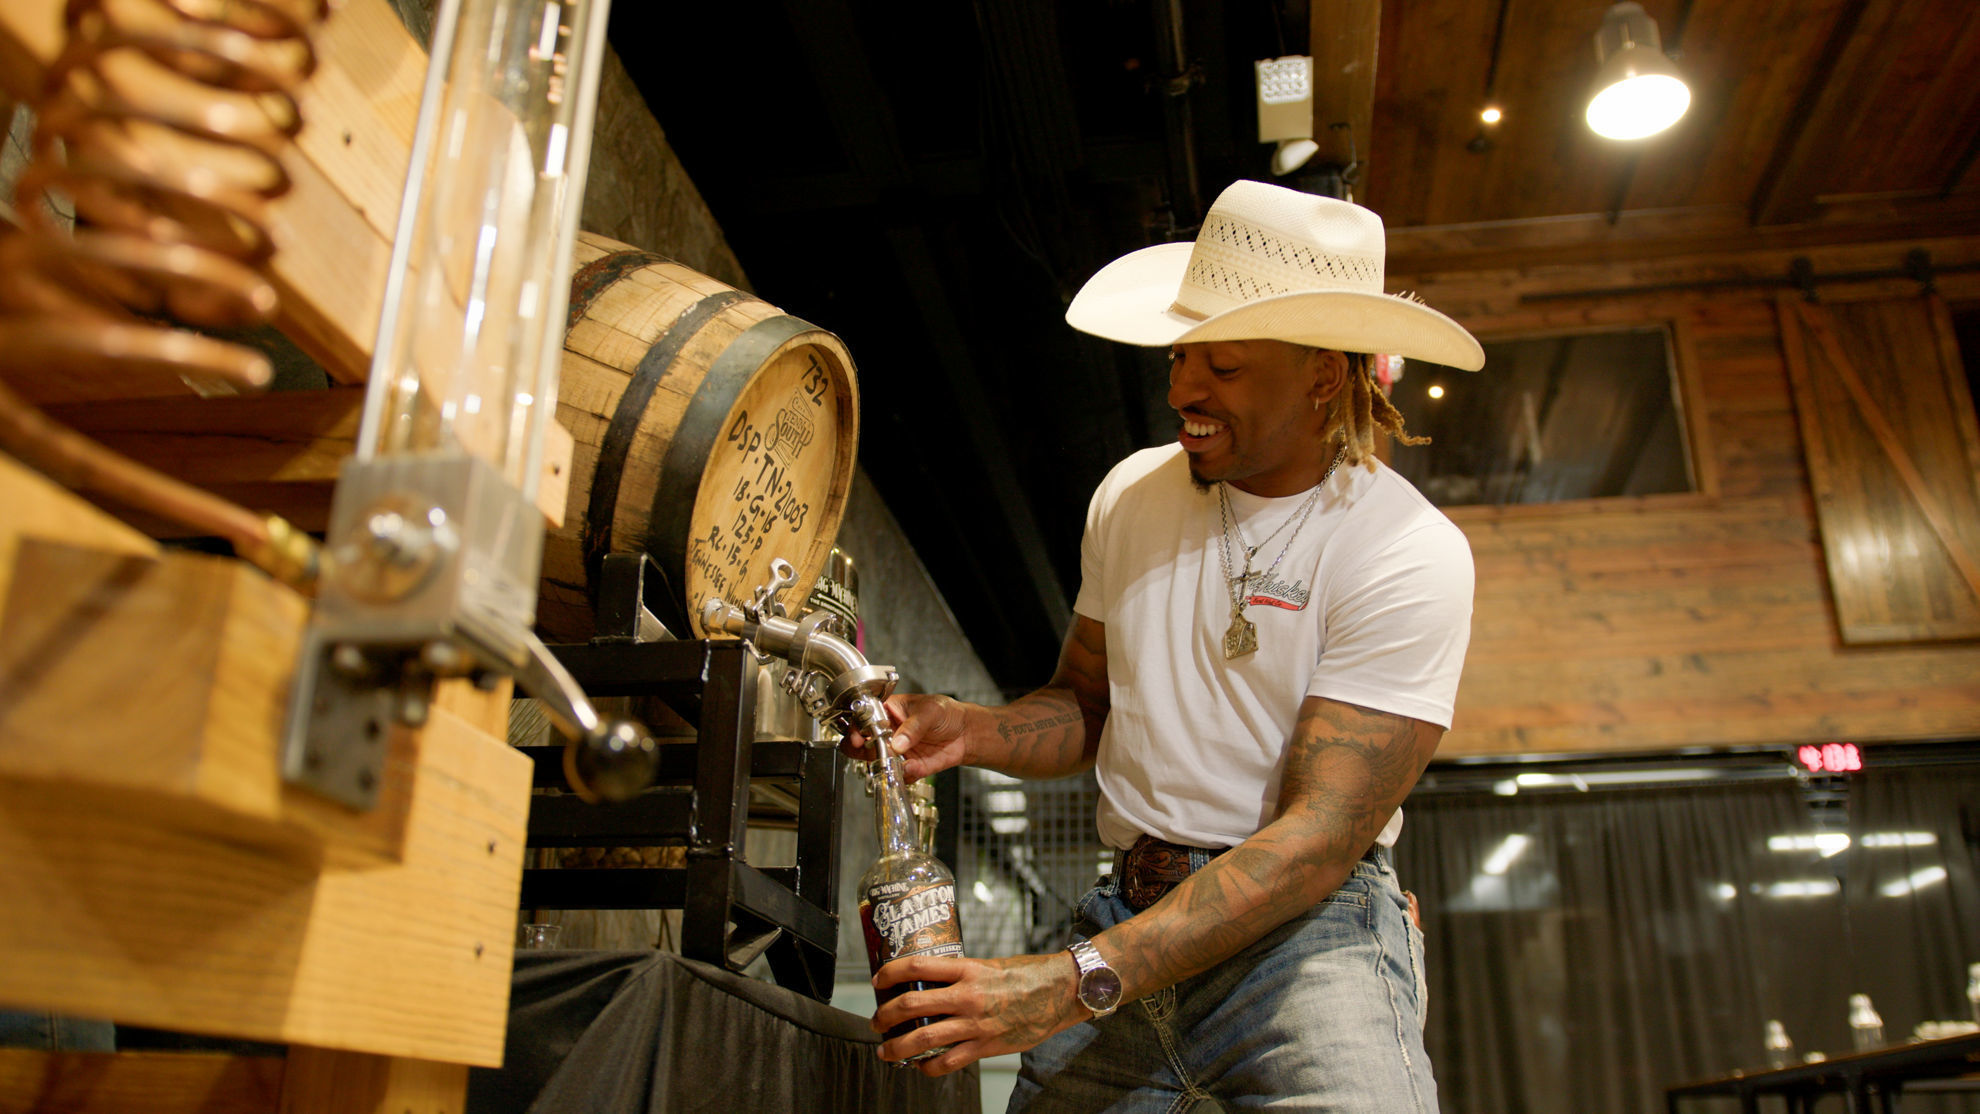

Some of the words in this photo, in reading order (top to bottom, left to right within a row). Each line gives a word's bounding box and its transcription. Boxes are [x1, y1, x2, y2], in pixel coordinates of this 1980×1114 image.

[802, 354, 829, 407] 732
[764, 408, 815, 459] SOUTH
[873, 885, 955, 937] CLAYTON
[889, 903, 951, 958] JAMES
